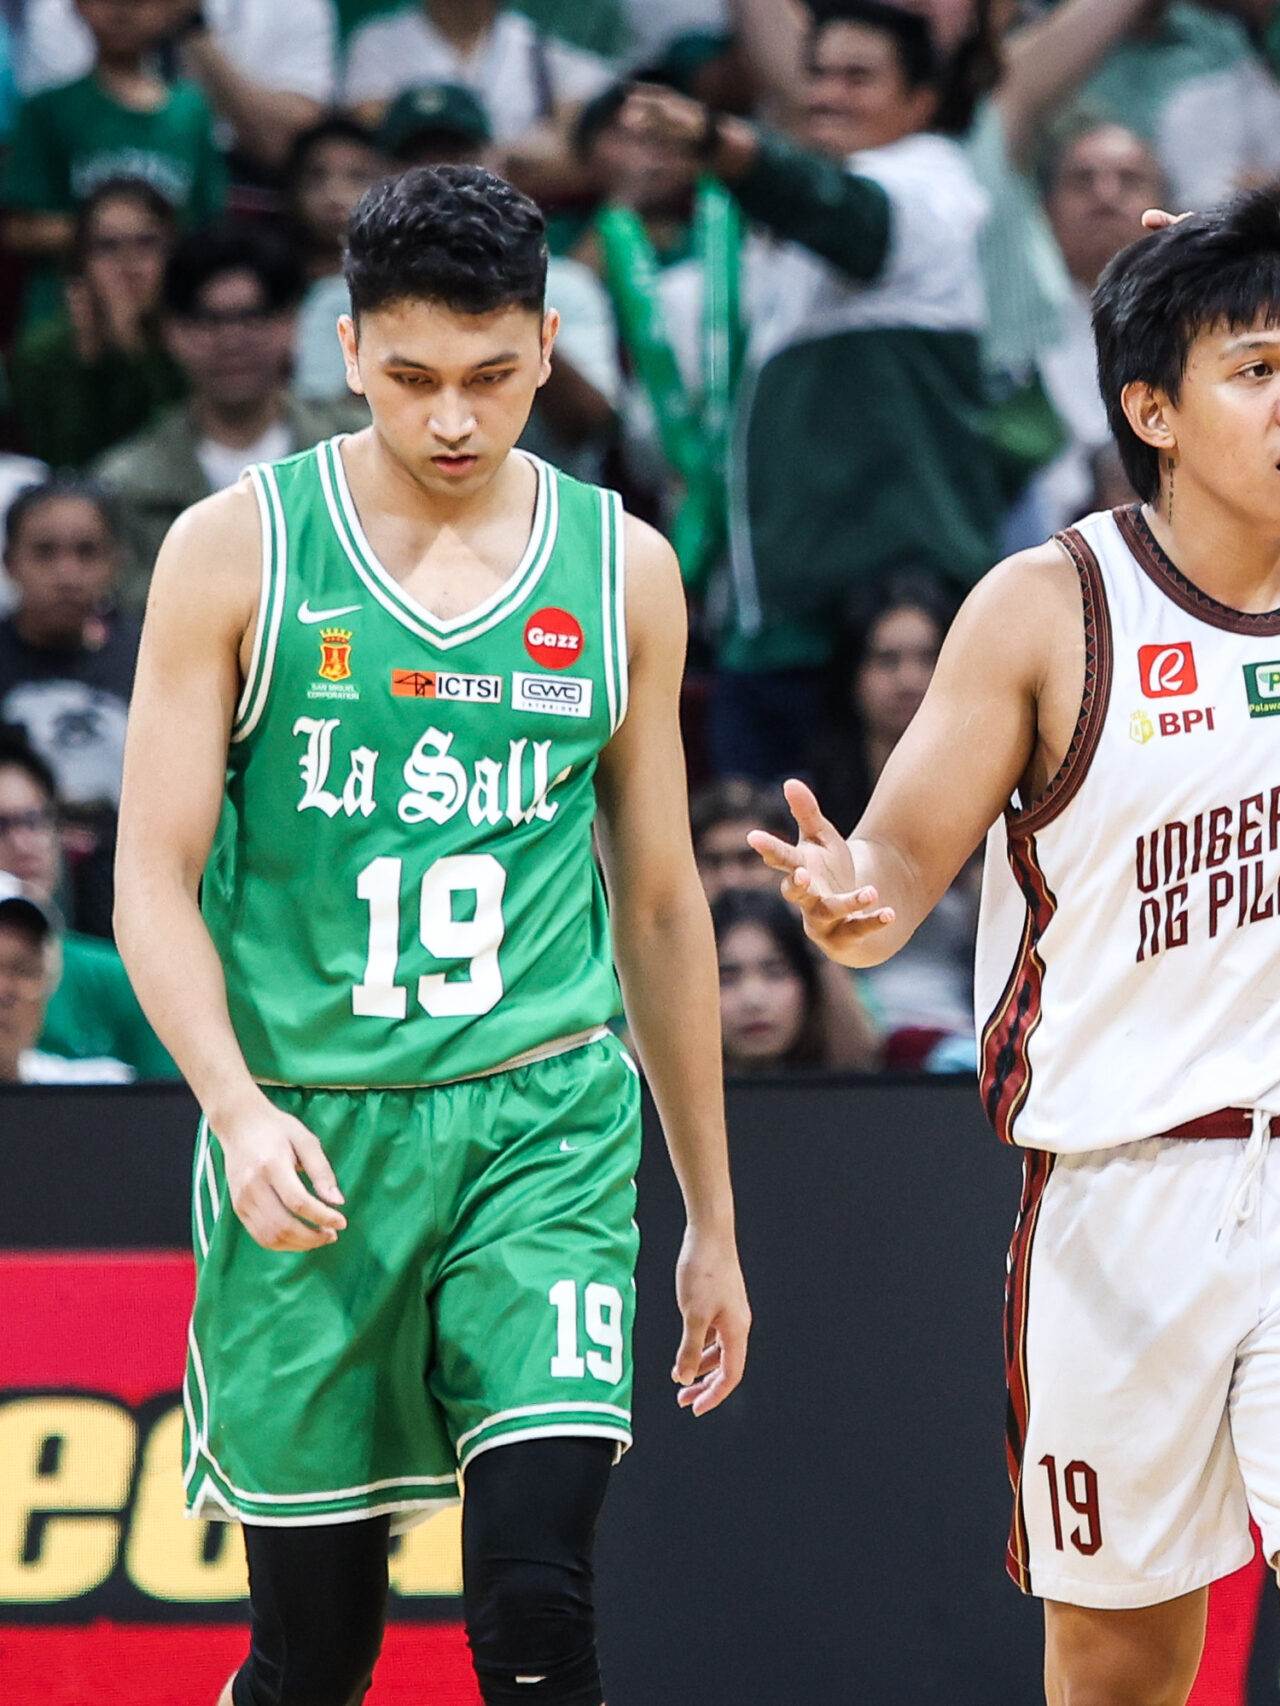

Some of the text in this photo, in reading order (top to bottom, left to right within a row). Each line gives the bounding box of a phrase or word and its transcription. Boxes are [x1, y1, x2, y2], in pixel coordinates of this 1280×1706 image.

[527, 627, 580, 650] Gazz
[438, 676, 499, 699] ICTSI
[527, 683, 578, 700] CWC
[1158, 707, 1215, 737] BPI
[292, 716, 379, 819] La
[352, 853, 507, 1020] 19
[1136, 882, 1188, 963] NG
[548, 1279, 624, 1386] 19
[1038, 1453, 1103, 1557] 19
